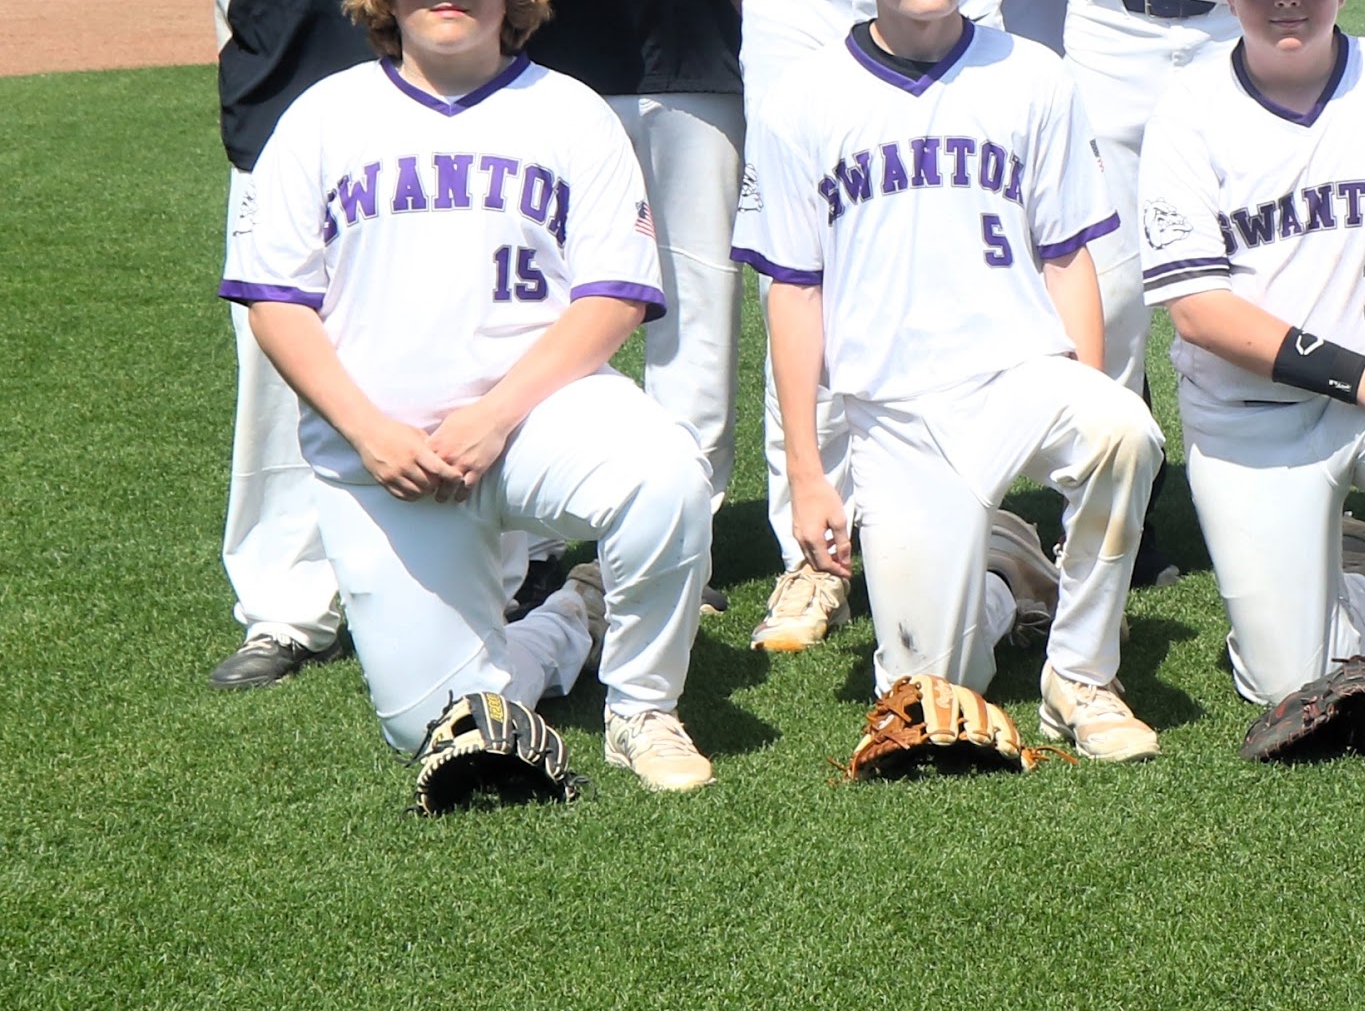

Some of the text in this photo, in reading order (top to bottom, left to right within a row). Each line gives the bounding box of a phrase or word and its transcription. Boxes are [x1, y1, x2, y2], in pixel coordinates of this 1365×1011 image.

[818, 135, 1026, 227] SWANTON
[980, 212, 1014, 269] 5
[492, 244, 548, 303] 15
